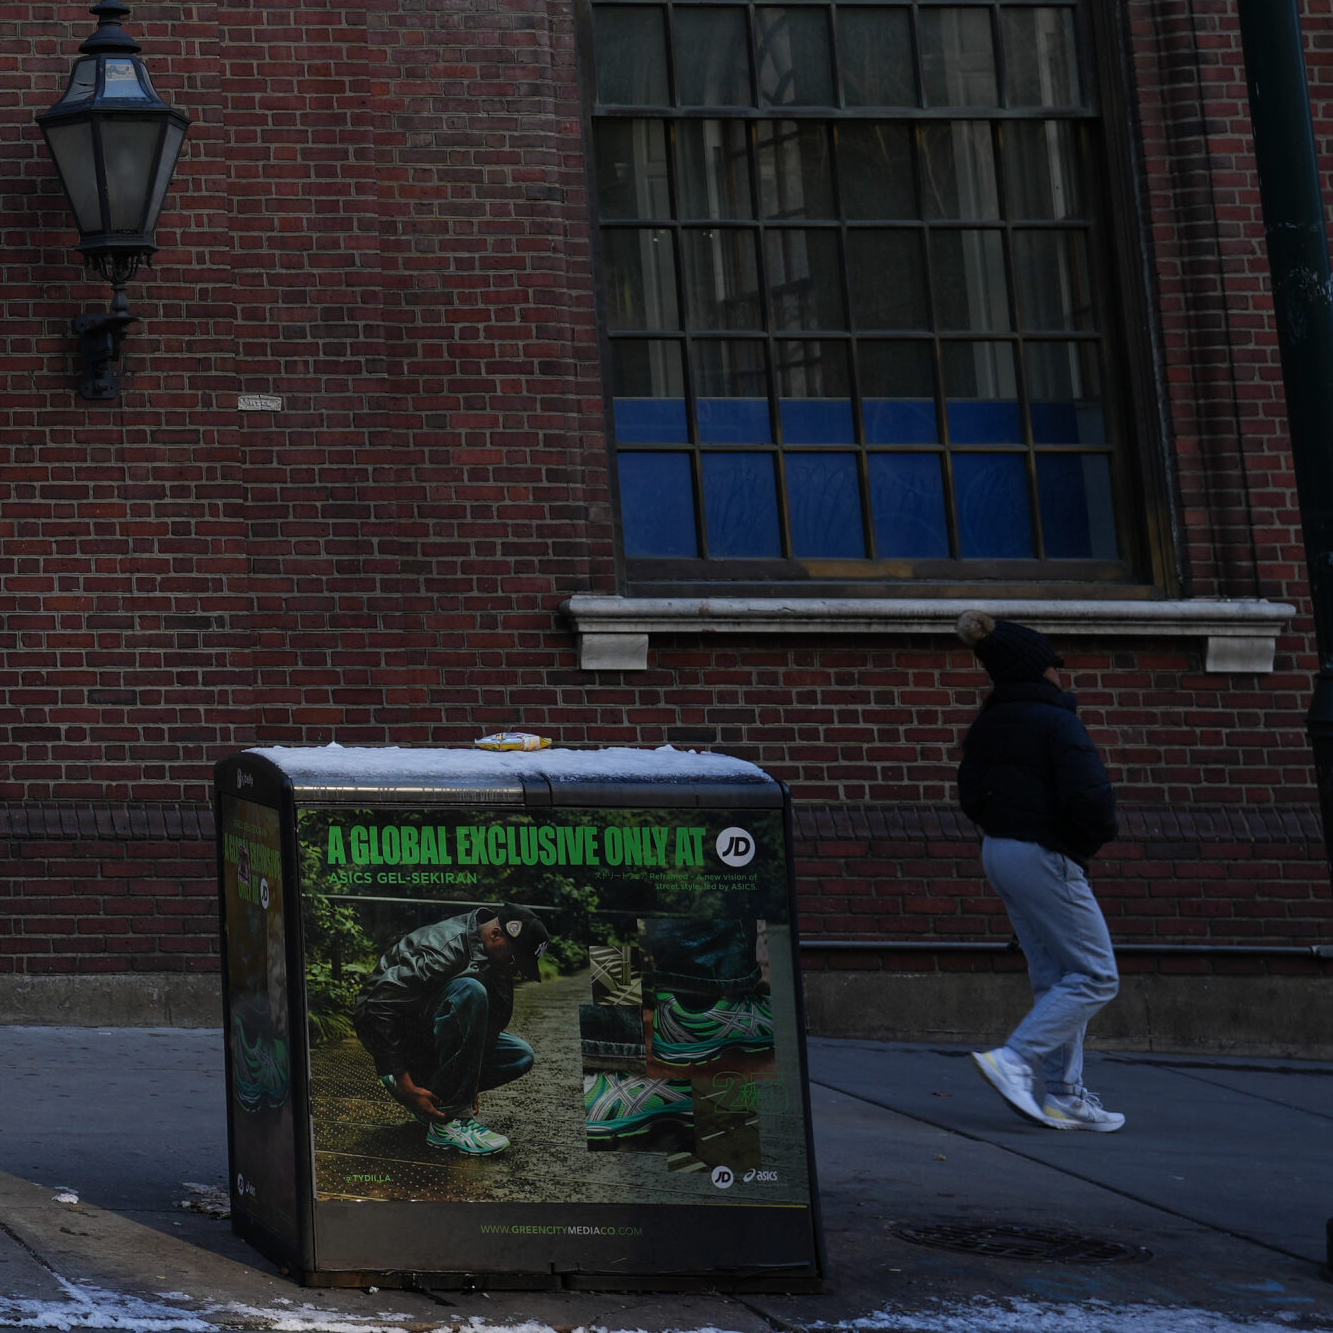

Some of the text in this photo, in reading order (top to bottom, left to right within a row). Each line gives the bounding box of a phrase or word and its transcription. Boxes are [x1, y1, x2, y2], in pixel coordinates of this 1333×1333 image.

[327, 825, 347, 865] A
[350, 824, 452, 866] GLOBAL
[456, 825, 600, 866] EXCLUSIVE
[604, 825, 669, 866] ONLY
[675, 826, 707, 866] AT
[329, 872, 478, 884] ASICS GEL-SEKIRAN
[649, 873, 689, 881] Reframed
[723, 873, 747, 881] vision
[748, 873, 758, 881] of
[718, 883, 729, 891] by
[346, 1174, 391, 1183] @TYDILLA
[756, 1170, 778, 1181] asics
[480, 1224, 644, 1237] WWW.GREENCITYMEDIACO.COM
